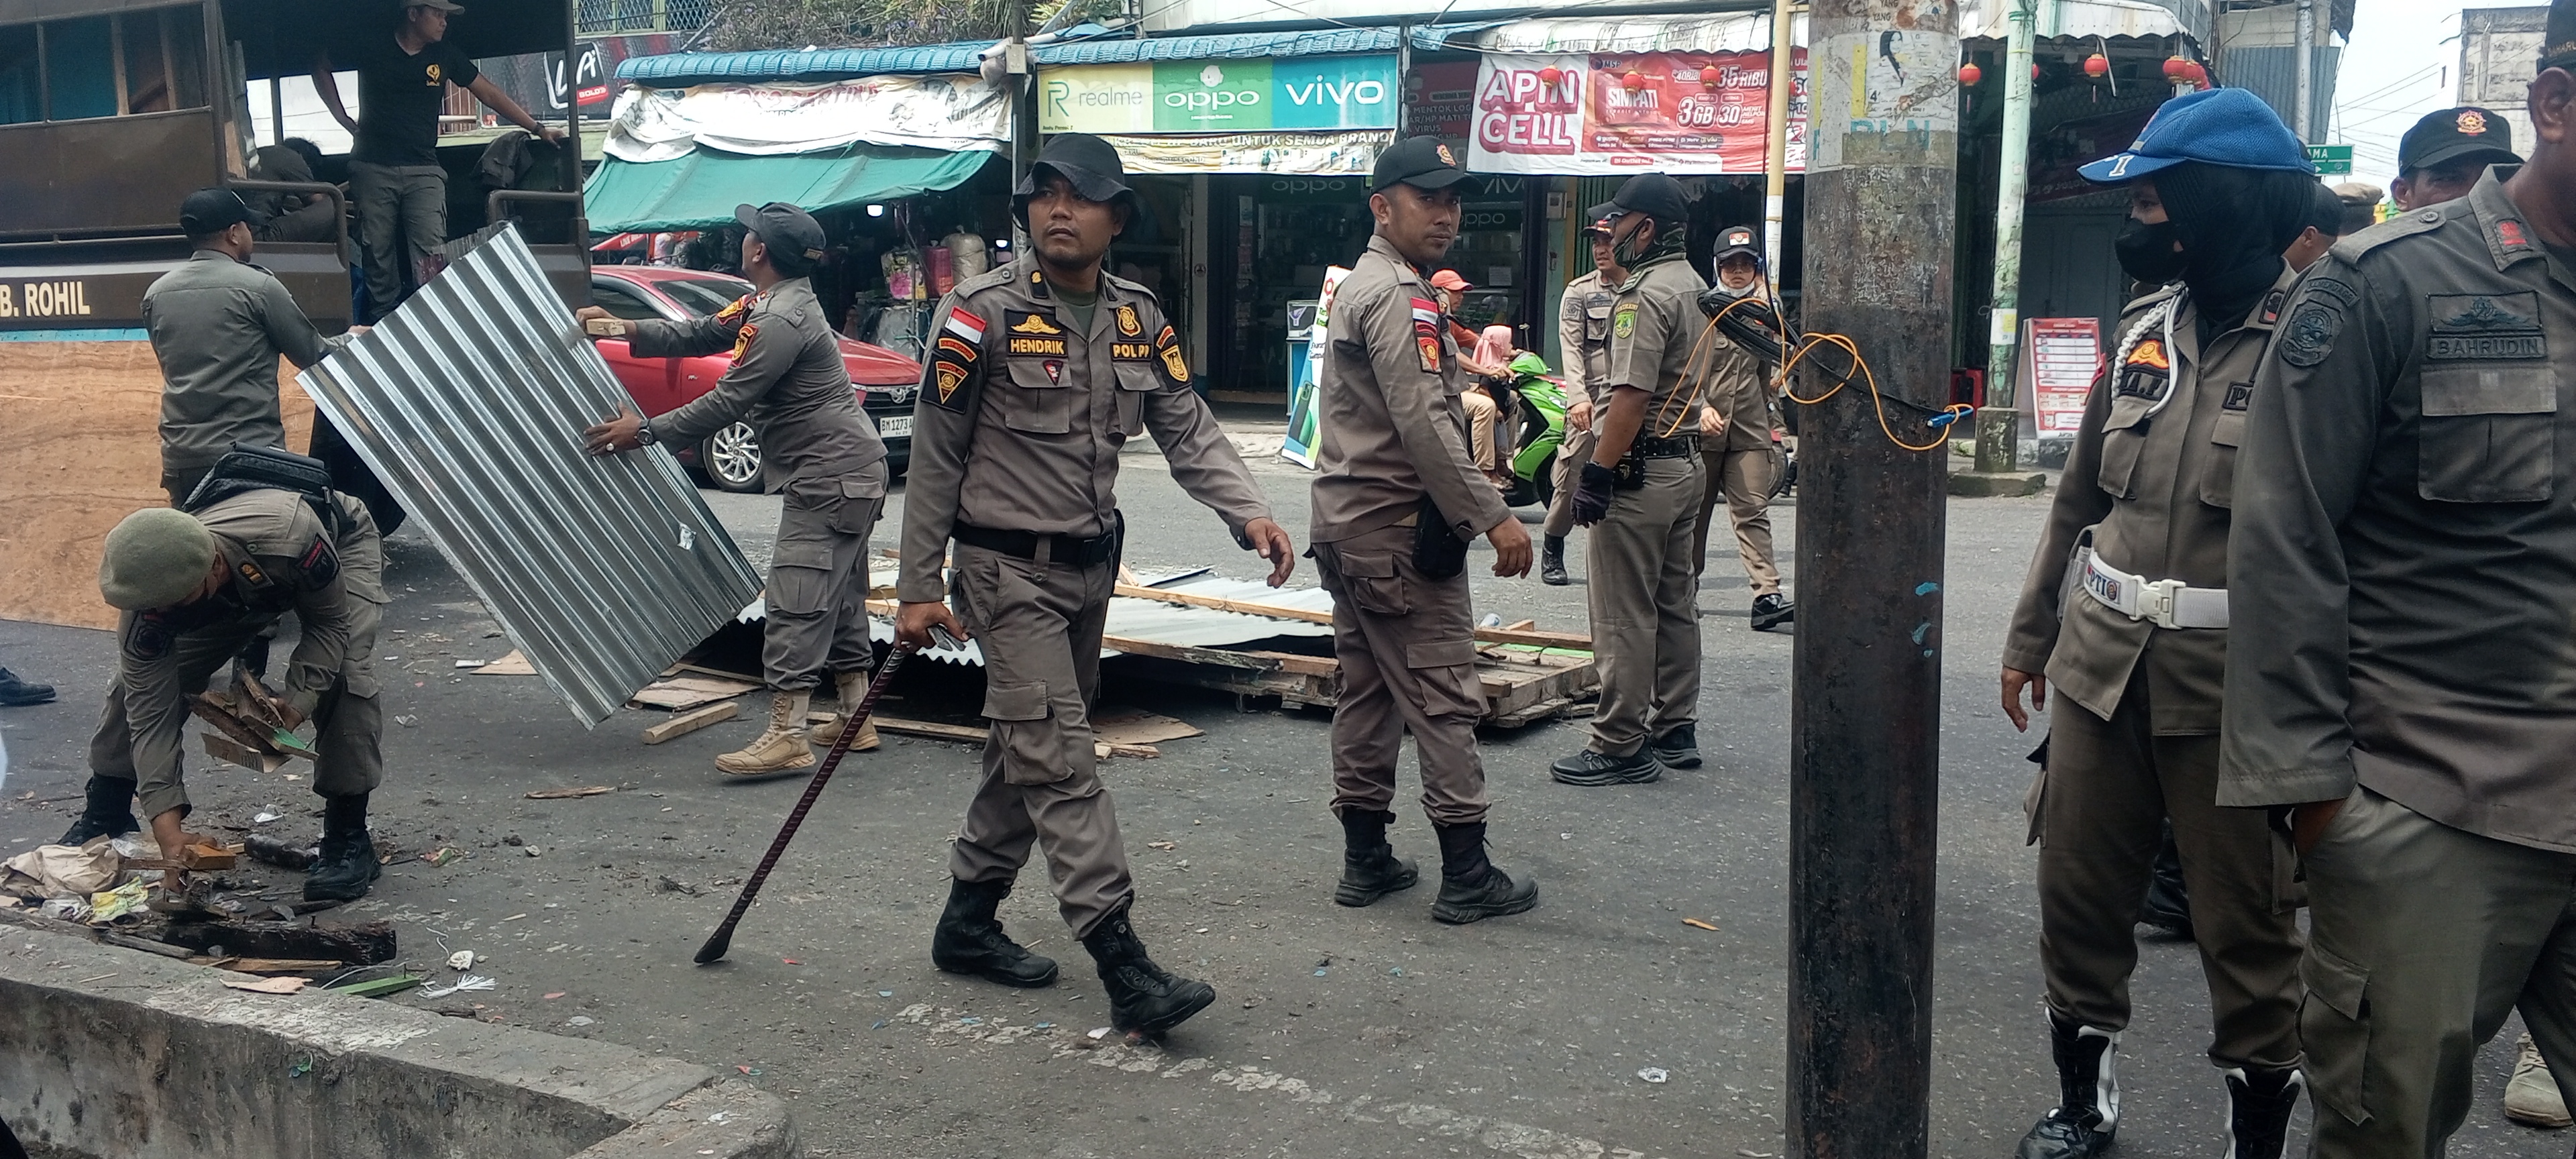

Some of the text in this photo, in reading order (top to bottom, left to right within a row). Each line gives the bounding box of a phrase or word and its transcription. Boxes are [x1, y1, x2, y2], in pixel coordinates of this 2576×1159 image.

[1604, 60, 1621, 68] MSP
[1285, 74, 1385, 106] vivo
[1483, 70, 1577, 105] APIN
[1079, 87, 1142, 106] realme
[1164, 91, 1260, 111] oppo
[1413, 105, 1451, 113] MENTOK
[1719, 105, 1741, 124] 30
[1439, 114, 1460, 122] MATI
[1481, 112, 1572, 147] CELL
[1232, 134, 1281, 147] UNTUK
[1285, 133, 1335, 146] SEMUA
[1338, 131, 1389, 145] BRAND
[1271, 180, 1346, 195] oppo
[1461, 213, 1505, 227] ppo
[24, 280, 91, 317] ROHIL
[1010, 339, 1065, 355] HENDRIK
[1113, 344, 1137, 358] POL
[2437, 338, 2539, 355] BAHRUDIN
[892, 419, 908, 431] 1273
